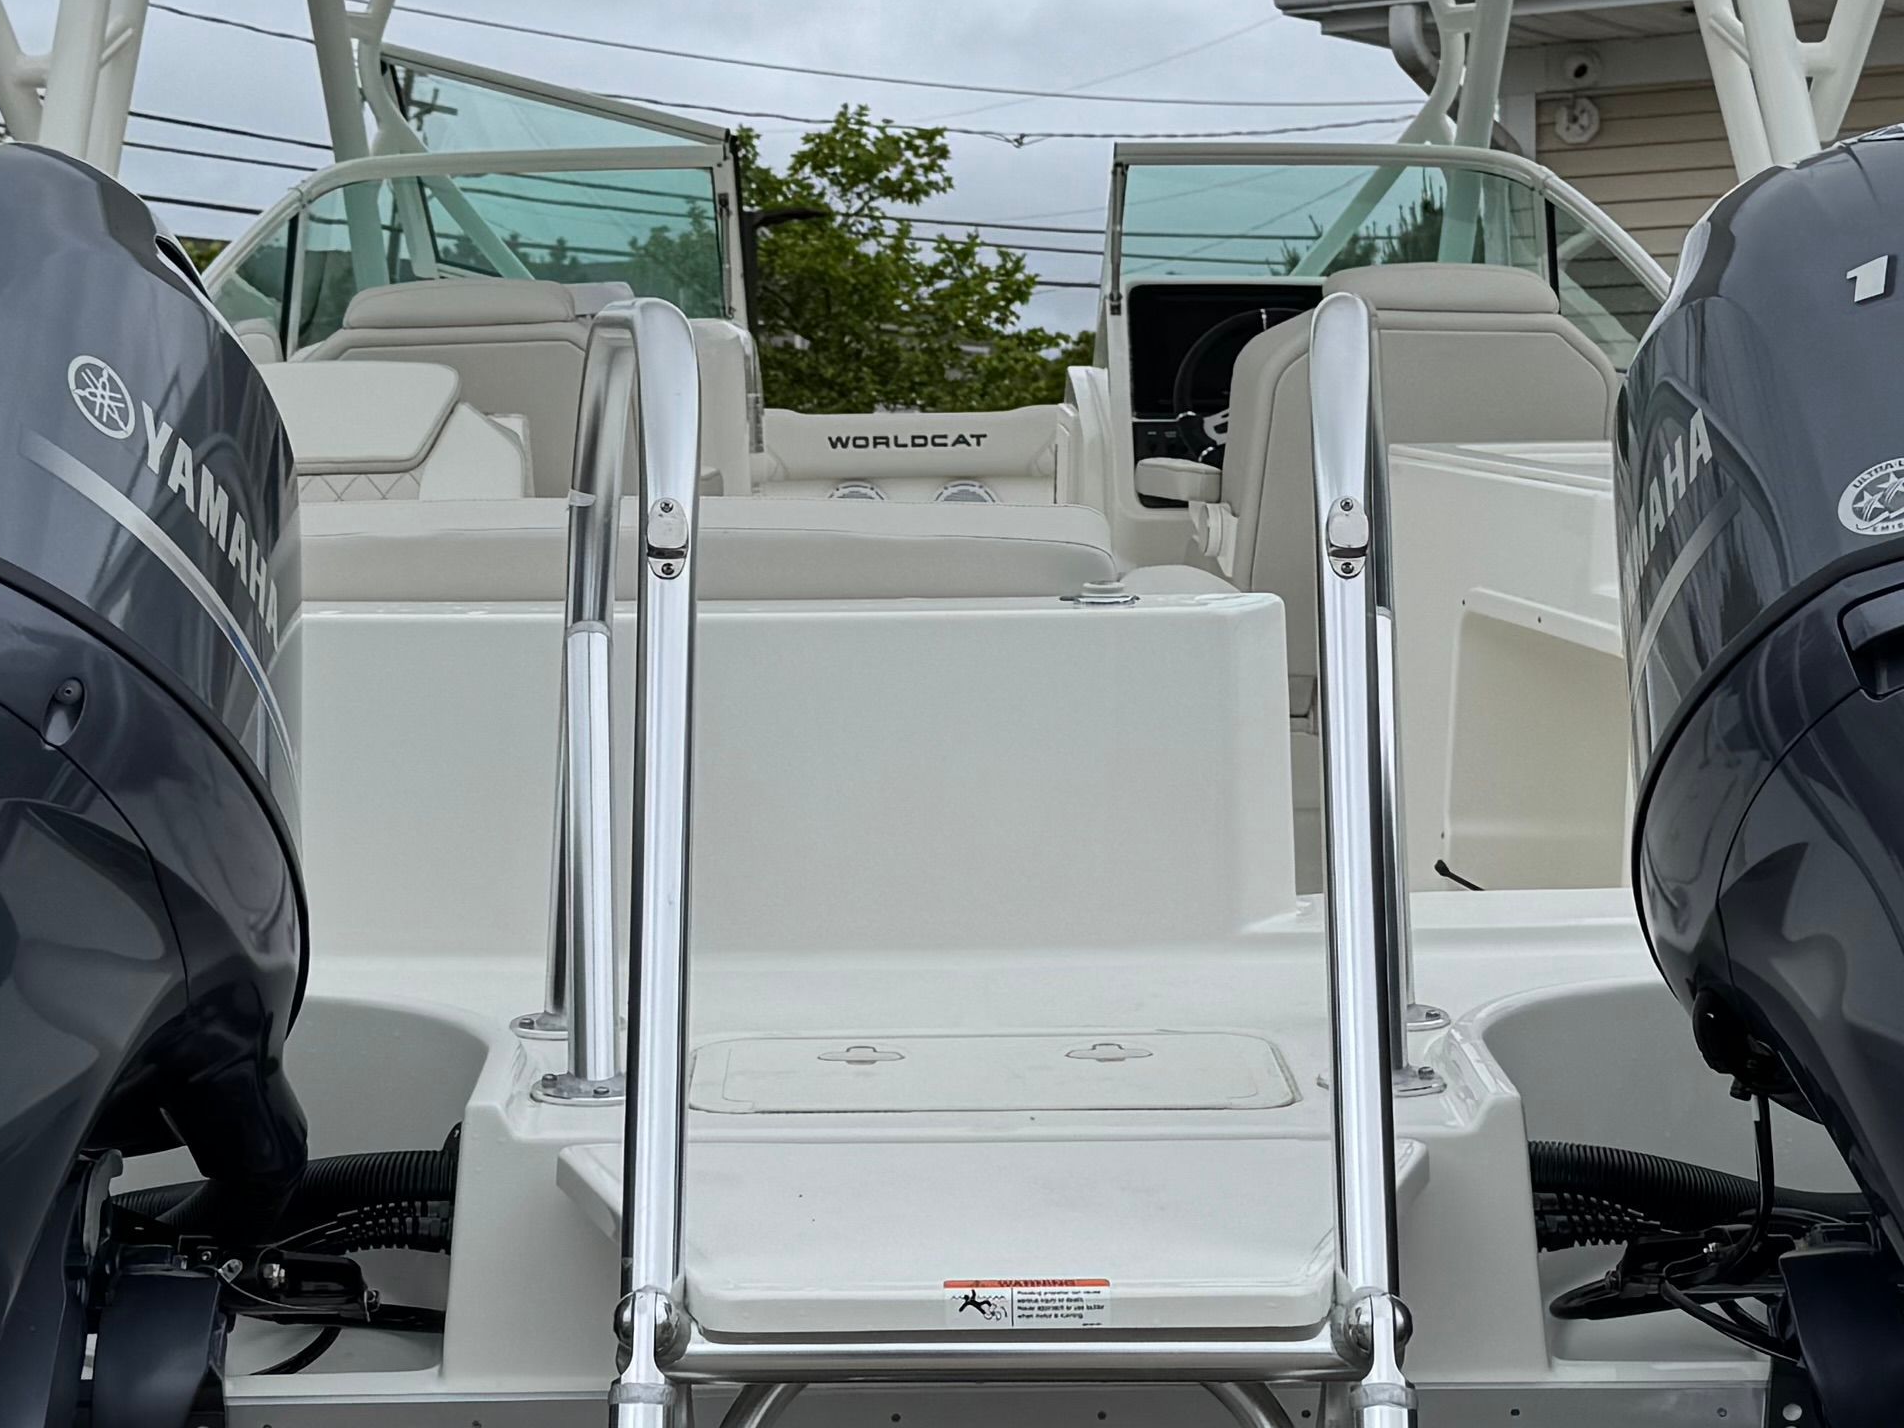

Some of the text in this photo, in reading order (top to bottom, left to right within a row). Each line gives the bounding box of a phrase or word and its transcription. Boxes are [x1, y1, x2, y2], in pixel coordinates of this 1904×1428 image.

[828, 434, 988, 449] WORLDCAT
[1853, 462, 1895, 489] ULTRA
[1631, 407, 1713, 578] MAHA
[142, 401, 280, 653] YAMAHA
[997, 1279, 1077, 1288] WARNING
